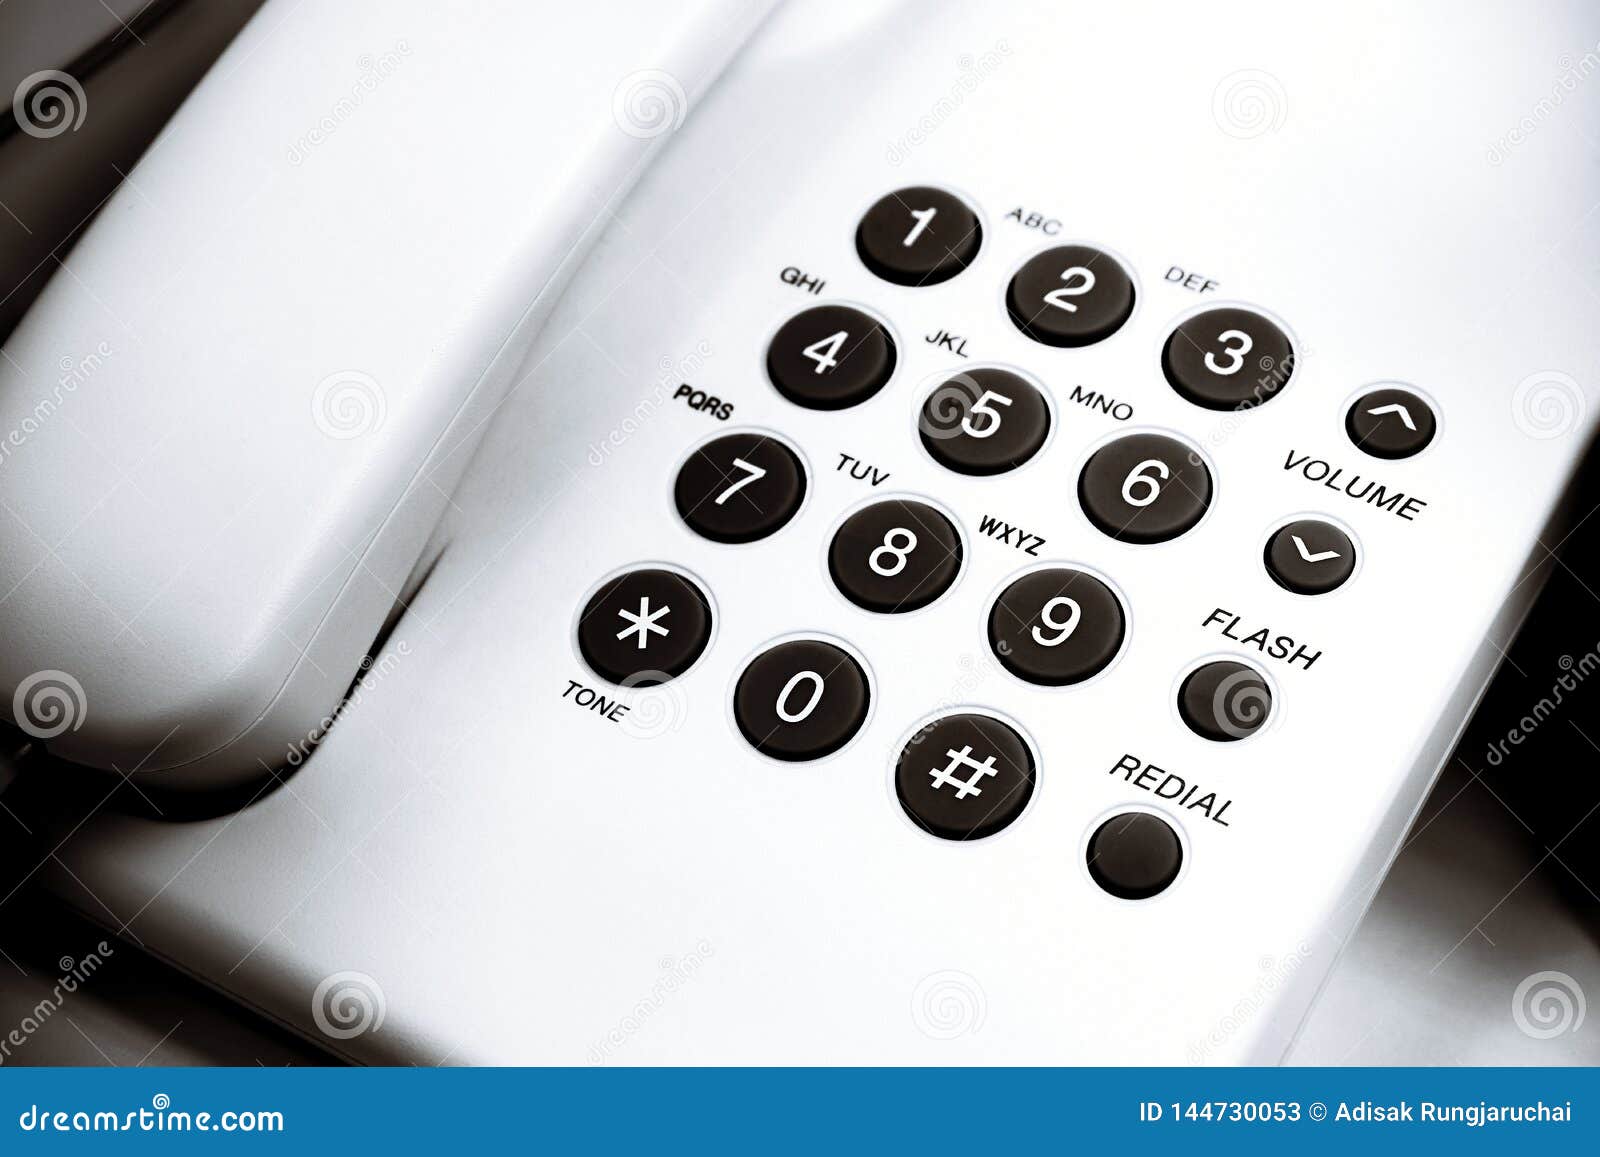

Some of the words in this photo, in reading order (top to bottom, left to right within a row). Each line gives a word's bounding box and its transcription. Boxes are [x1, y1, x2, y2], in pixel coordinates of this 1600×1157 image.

[904, 207, 938, 247] 1
[1006, 206, 1064, 236] ABC
[780, 267, 825, 296] GHI
[1043, 266, 1096, 313] 2
[1164, 266, 1220, 294] DEF
[803, 331, 849, 374] 4
[925, 330, 968, 358] JKL
[1204, 329, 1253, 375] 3
[672, 383, 735, 421] PQRS
[961, 390, 1013, 438] 5
[1069, 385, 1134, 421] MNO
[715, 458, 766, 505] 7
[836, 453, 891, 487] TUV
[1121, 459, 1170, 507] 6
[1284, 449, 1428, 520] VOLUME
[868, 527, 918, 577] 8
[978, 514, 1047, 557] WXYZ
[1031, 596, 1081, 647] 9
[1201, 607, 1323, 671] FLASH
[562, 680, 631, 723] TONE
[776, 670, 825, 723] 0
[1110, 753, 1233, 827] REDIAL
